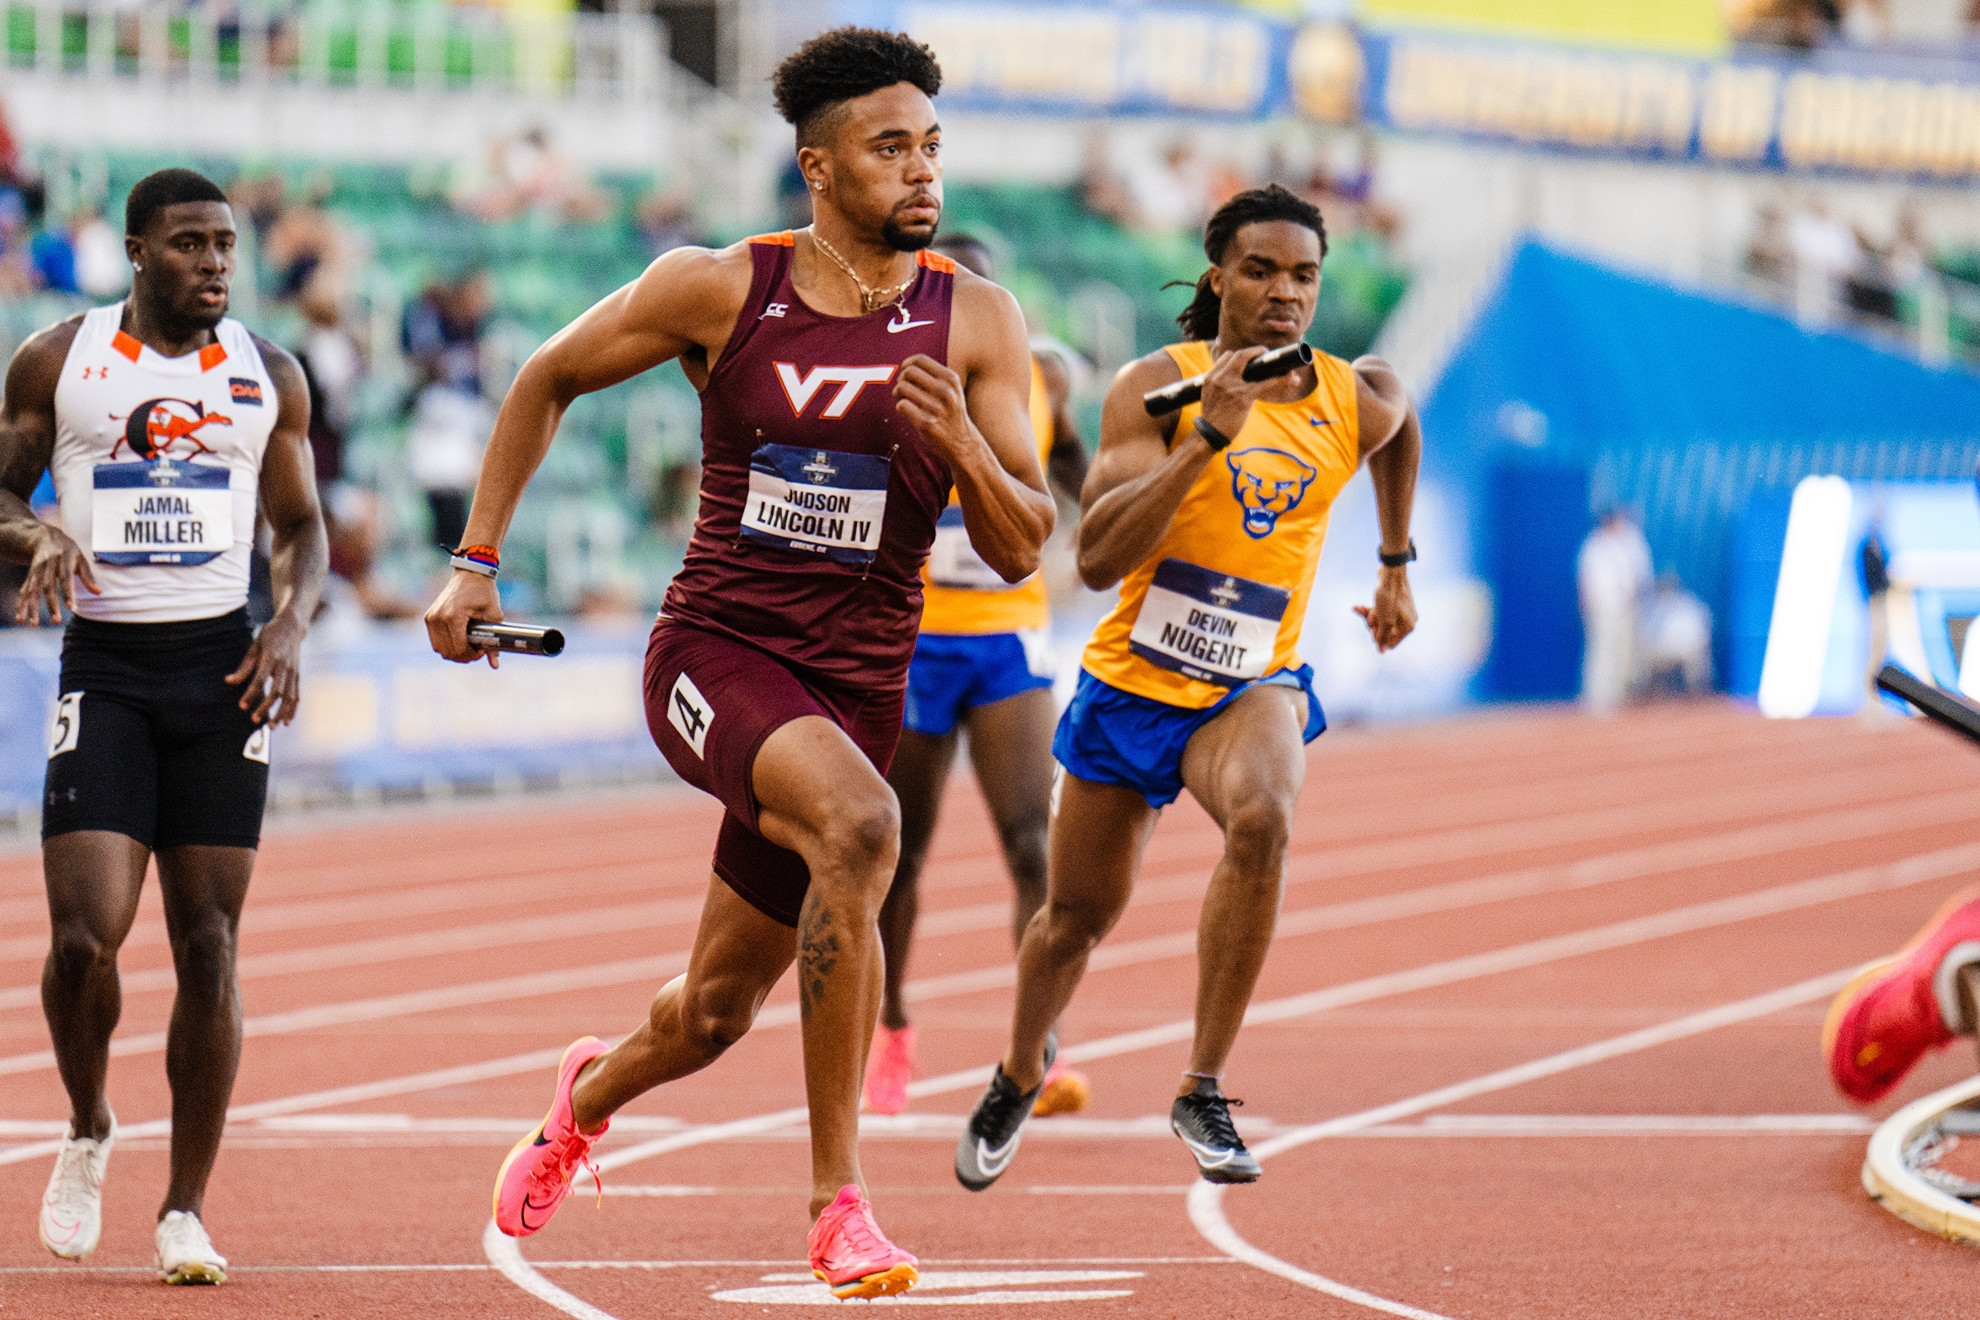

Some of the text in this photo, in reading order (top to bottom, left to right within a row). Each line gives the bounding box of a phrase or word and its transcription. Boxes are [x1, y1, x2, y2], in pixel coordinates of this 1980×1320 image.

[772, 361, 899, 420] VT
[134, 497, 193, 515] JAMAL
[757, 501, 871, 543] LINCOLN IV
[784, 489, 851, 514] JUDSON
[124, 520, 203, 544] MILLER
[1187, 608, 1238, 637] DEVIN
[1160, 621, 1248, 670] NUGENT
[55, 697, 72, 751] 5
[675, 687, 705, 742] 4
